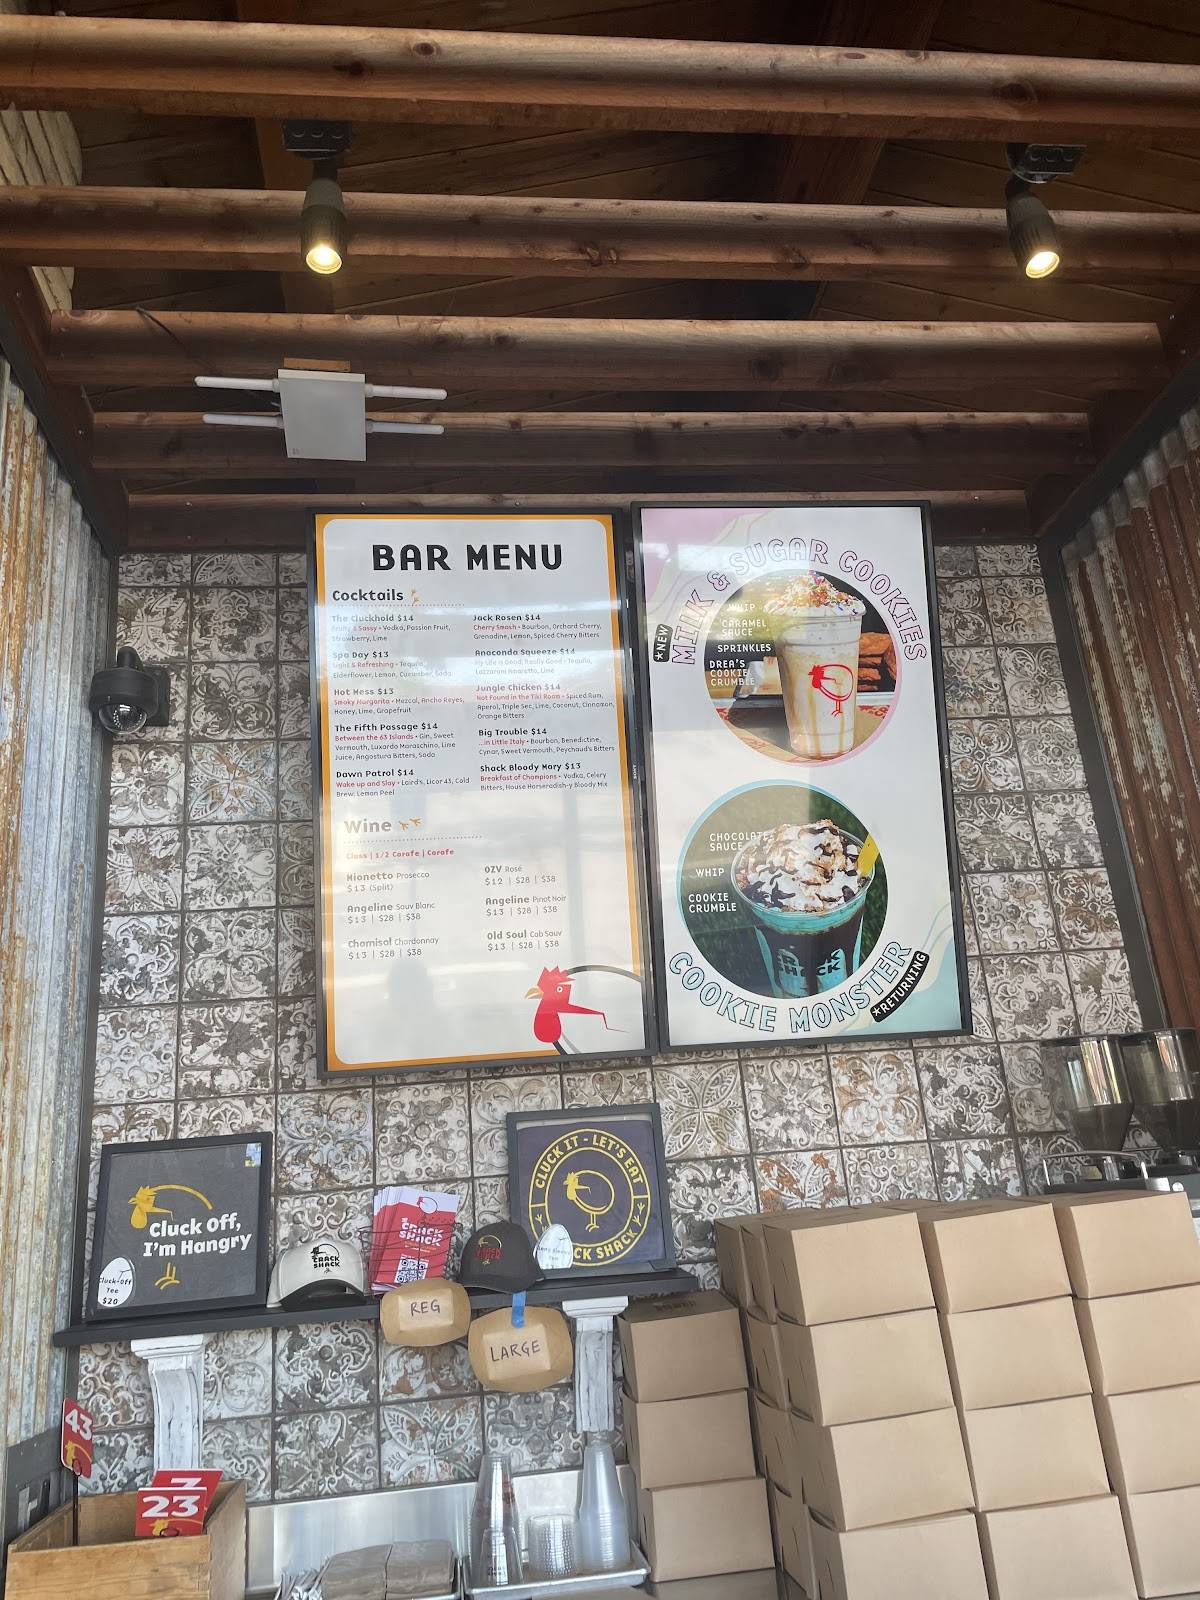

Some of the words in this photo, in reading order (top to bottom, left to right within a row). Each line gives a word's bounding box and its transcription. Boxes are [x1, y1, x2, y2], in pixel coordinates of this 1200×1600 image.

[372, 544, 452, 570] BAR
[466, 544, 562, 570] MENU
[332, 588, 404, 601] Cocktails
[672, 590, 714, 665] MILK
[707, 570, 730, 592] &
[729, 538, 828, 575] SUGAR
[838, 550, 926, 660] COOKIES
[351, 614, 394, 622] Cluckhold
[398, 614, 414, 622] $14
[722, 619, 766, 628] CARAMEL
[722, 628, 753, 636] SAUCE
[656, 625, 669, 651] NEW
[520, 648, 557, 656] Squeeze
[717, 644, 771, 652] SPRINKLES
[332, 652, 350, 660] Spa
[352, 652, 369, 660] Day
[710, 660, 745, 669] DREA'S
[710, 669, 748, 677] COOKIE
[711, 678, 755, 686] CRUMBLE
[476, 684, 505, 693] Jungle
[508, 683, 542, 691] Chicken
[544, 682, 560, 691] $14
[335, 724, 351, 732] The
[355, 724, 377, 732] Fifth
[380, 723, 418, 732] Passage
[421, 722, 438, 730] $14
[335, 734, 365, 742] Between
[478, 729, 492, 738] Big
[495, 728, 528, 736] Trouble
[531, 728, 547, 736] $14
[400, 742, 440, 750] Maraschino,
[356, 753, 391, 761] Angostura
[480, 764, 506, 772] Shack
[509, 763, 539, 772] Bloody
[542, 763, 562, 771] Mary
[565, 762, 581, 770] $13
[366, 769, 394, 777] Patrol
[397, 769, 414, 777] $14
[586, 772, 607, 780] Celery
[574, 781, 596, 789] Bloody
[344, 818, 392, 833] Wine
[709, 832, 769, 841] CHOCOLATE
[710, 842, 743, 851] SAUCE
[392, 850, 419, 858] Carafe
[484, 865, 502, 873] OZV
[696, 868, 724, 877] WHIP
[346, 872, 394, 881] Mionetto
[485, 878, 502, 886] $12
[347, 884, 366, 892] $13
[369, 883, 393, 892] (Split)
[485, 895, 530, 907] Angeline
[552, 894, 566, 902] Noir
[688, 892, 728, 902] COOKIE
[347, 902, 393, 914] Angeline
[415, 902, 435, 910] Blanc
[486, 908, 504, 917] $13
[517, 907, 532, 915] $28
[689, 903, 737, 913] CRUMBLE
[347, 916, 366, 924] $13
[378, 914, 394, 922] $28
[406, 913, 421, 921] $38
[487, 931, 502, 940] Old
[506, 930, 527, 939] Soul
[530, 930, 544, 938] Cab
[348, 937, 392, 948] Chamisal
[394, 936, 439, 946] Chardonnay
[487, 943, 506, 952] $13
[544, 940, 560, 948] $38
[348, 952, 367, 960] $13
[380, 950, 395, 958] $28
[407, 948, 422, 957] $38
[668, 952, 776, 1033] COOKIE
[790, 941, 912, 1033] MONSTER
[880, 952, 926, 1013] RETURNING
[535, 1145, 564, 1188] CLUCK
[564, 1135, 579, 1151] IT
[592, 1134, 626, 1158] LET'S
[624, 1158, 643, 1184] EAT
[149, 1219, 202, 1239] Cluck
[207, 1212, 242, 1232] Off,
[402, 1223, 444, 1238] CRACK
[399, 1230, 442, 1246] SHACK
[143, 1239, 176, 1257] I'm
[180, 1233, 253, 1254] Hangry
[596, 1229, 638, 1259] SHACK
[103, 1297, 118, 1305] $20
[410, 1300, 441, 1317] REG
[491, 1340, 541, 1362] LARGE
[65, 1408, 93, 1440] 43
[142, 1495, 200, 1518] 23
